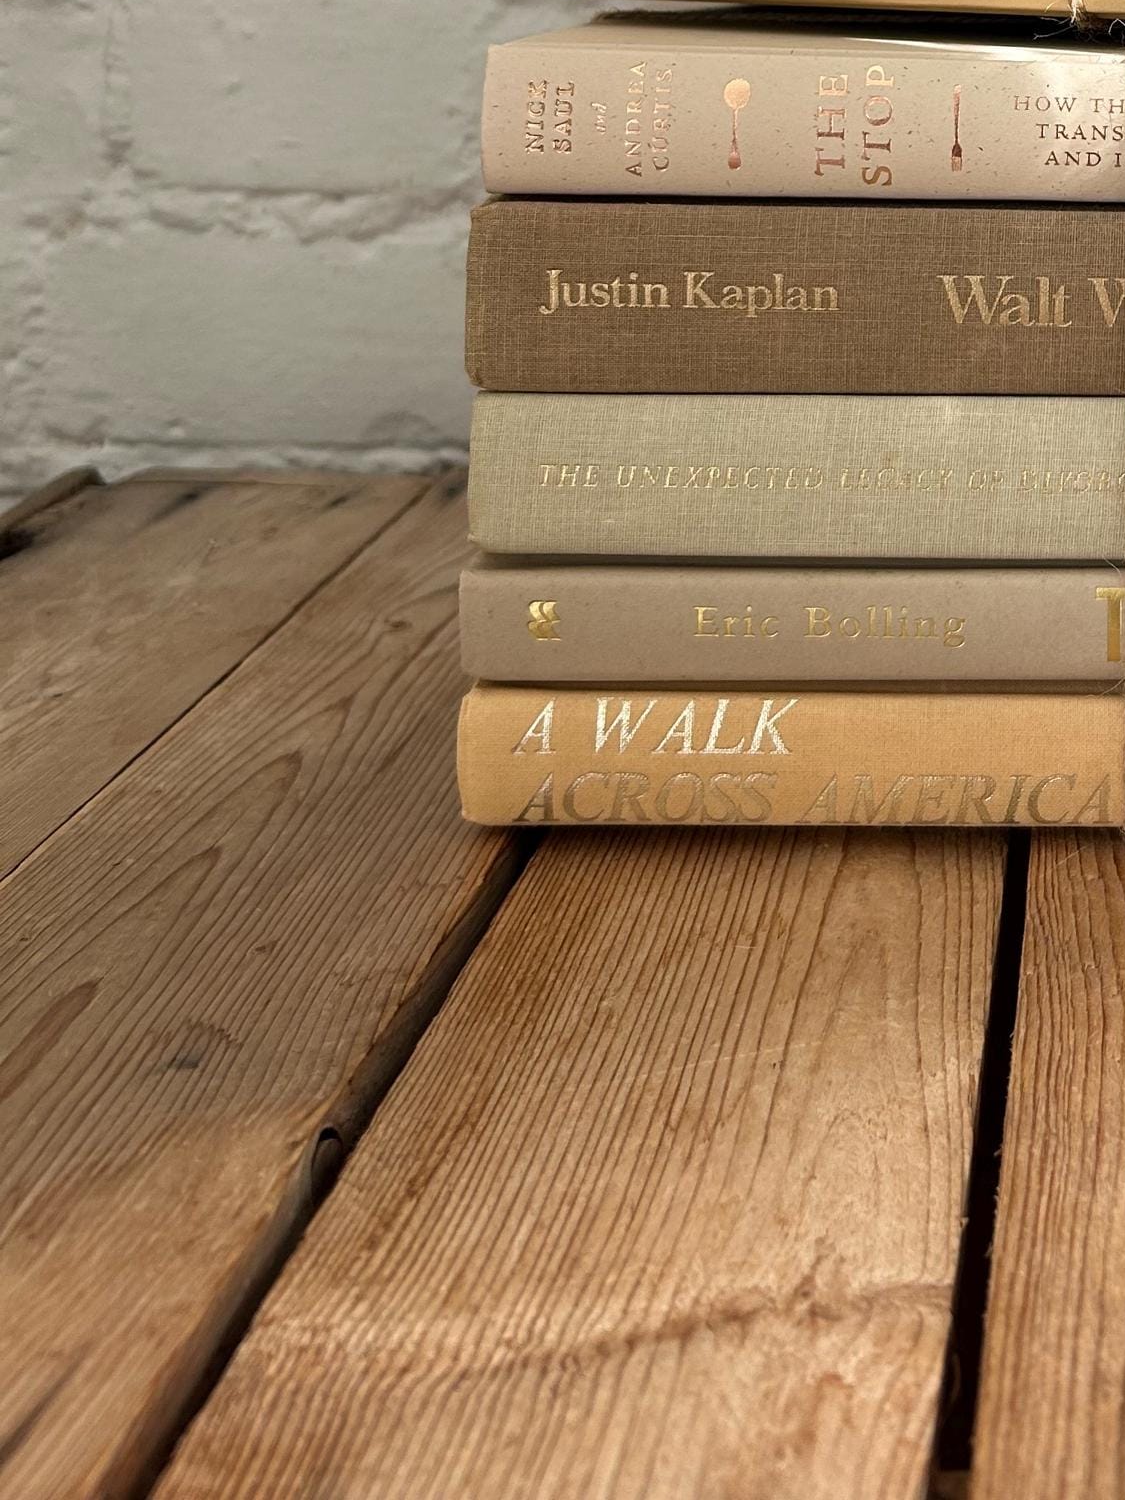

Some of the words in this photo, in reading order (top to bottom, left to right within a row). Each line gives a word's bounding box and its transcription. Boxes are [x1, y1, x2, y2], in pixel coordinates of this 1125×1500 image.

[525, 79, 549, 155] NICK
[553, 81, 576, 155] SAUL
[593, 100, 609, 135] and
[624, 60, 649, 178] ANDREA
[652, 68, 675, 173] CURTIS
[815, 73, 849, 177] THE
[860, 64, 895, 187] STOP
[1014, 94, 1077, 114] HOW
[1044, 150, 1102, 168] AND
[540, 269, 670, 315] Justin
[682, 271, 841, 318] Kaplan
[936, 274, 1072, 328] Walt
[540, 463, 601, 488] THE
[616, 464, 825, 490] UNEXPECTED
[693, 605, 780, 638] Eric
[804, 605, 967, 648] Bolling
[510, 696, 557, 756] A
[593, 695, 800, 756] WALK
[510, 770, 779, 825] ACROSS
[794, 771, 1113, 825] AMERICA
